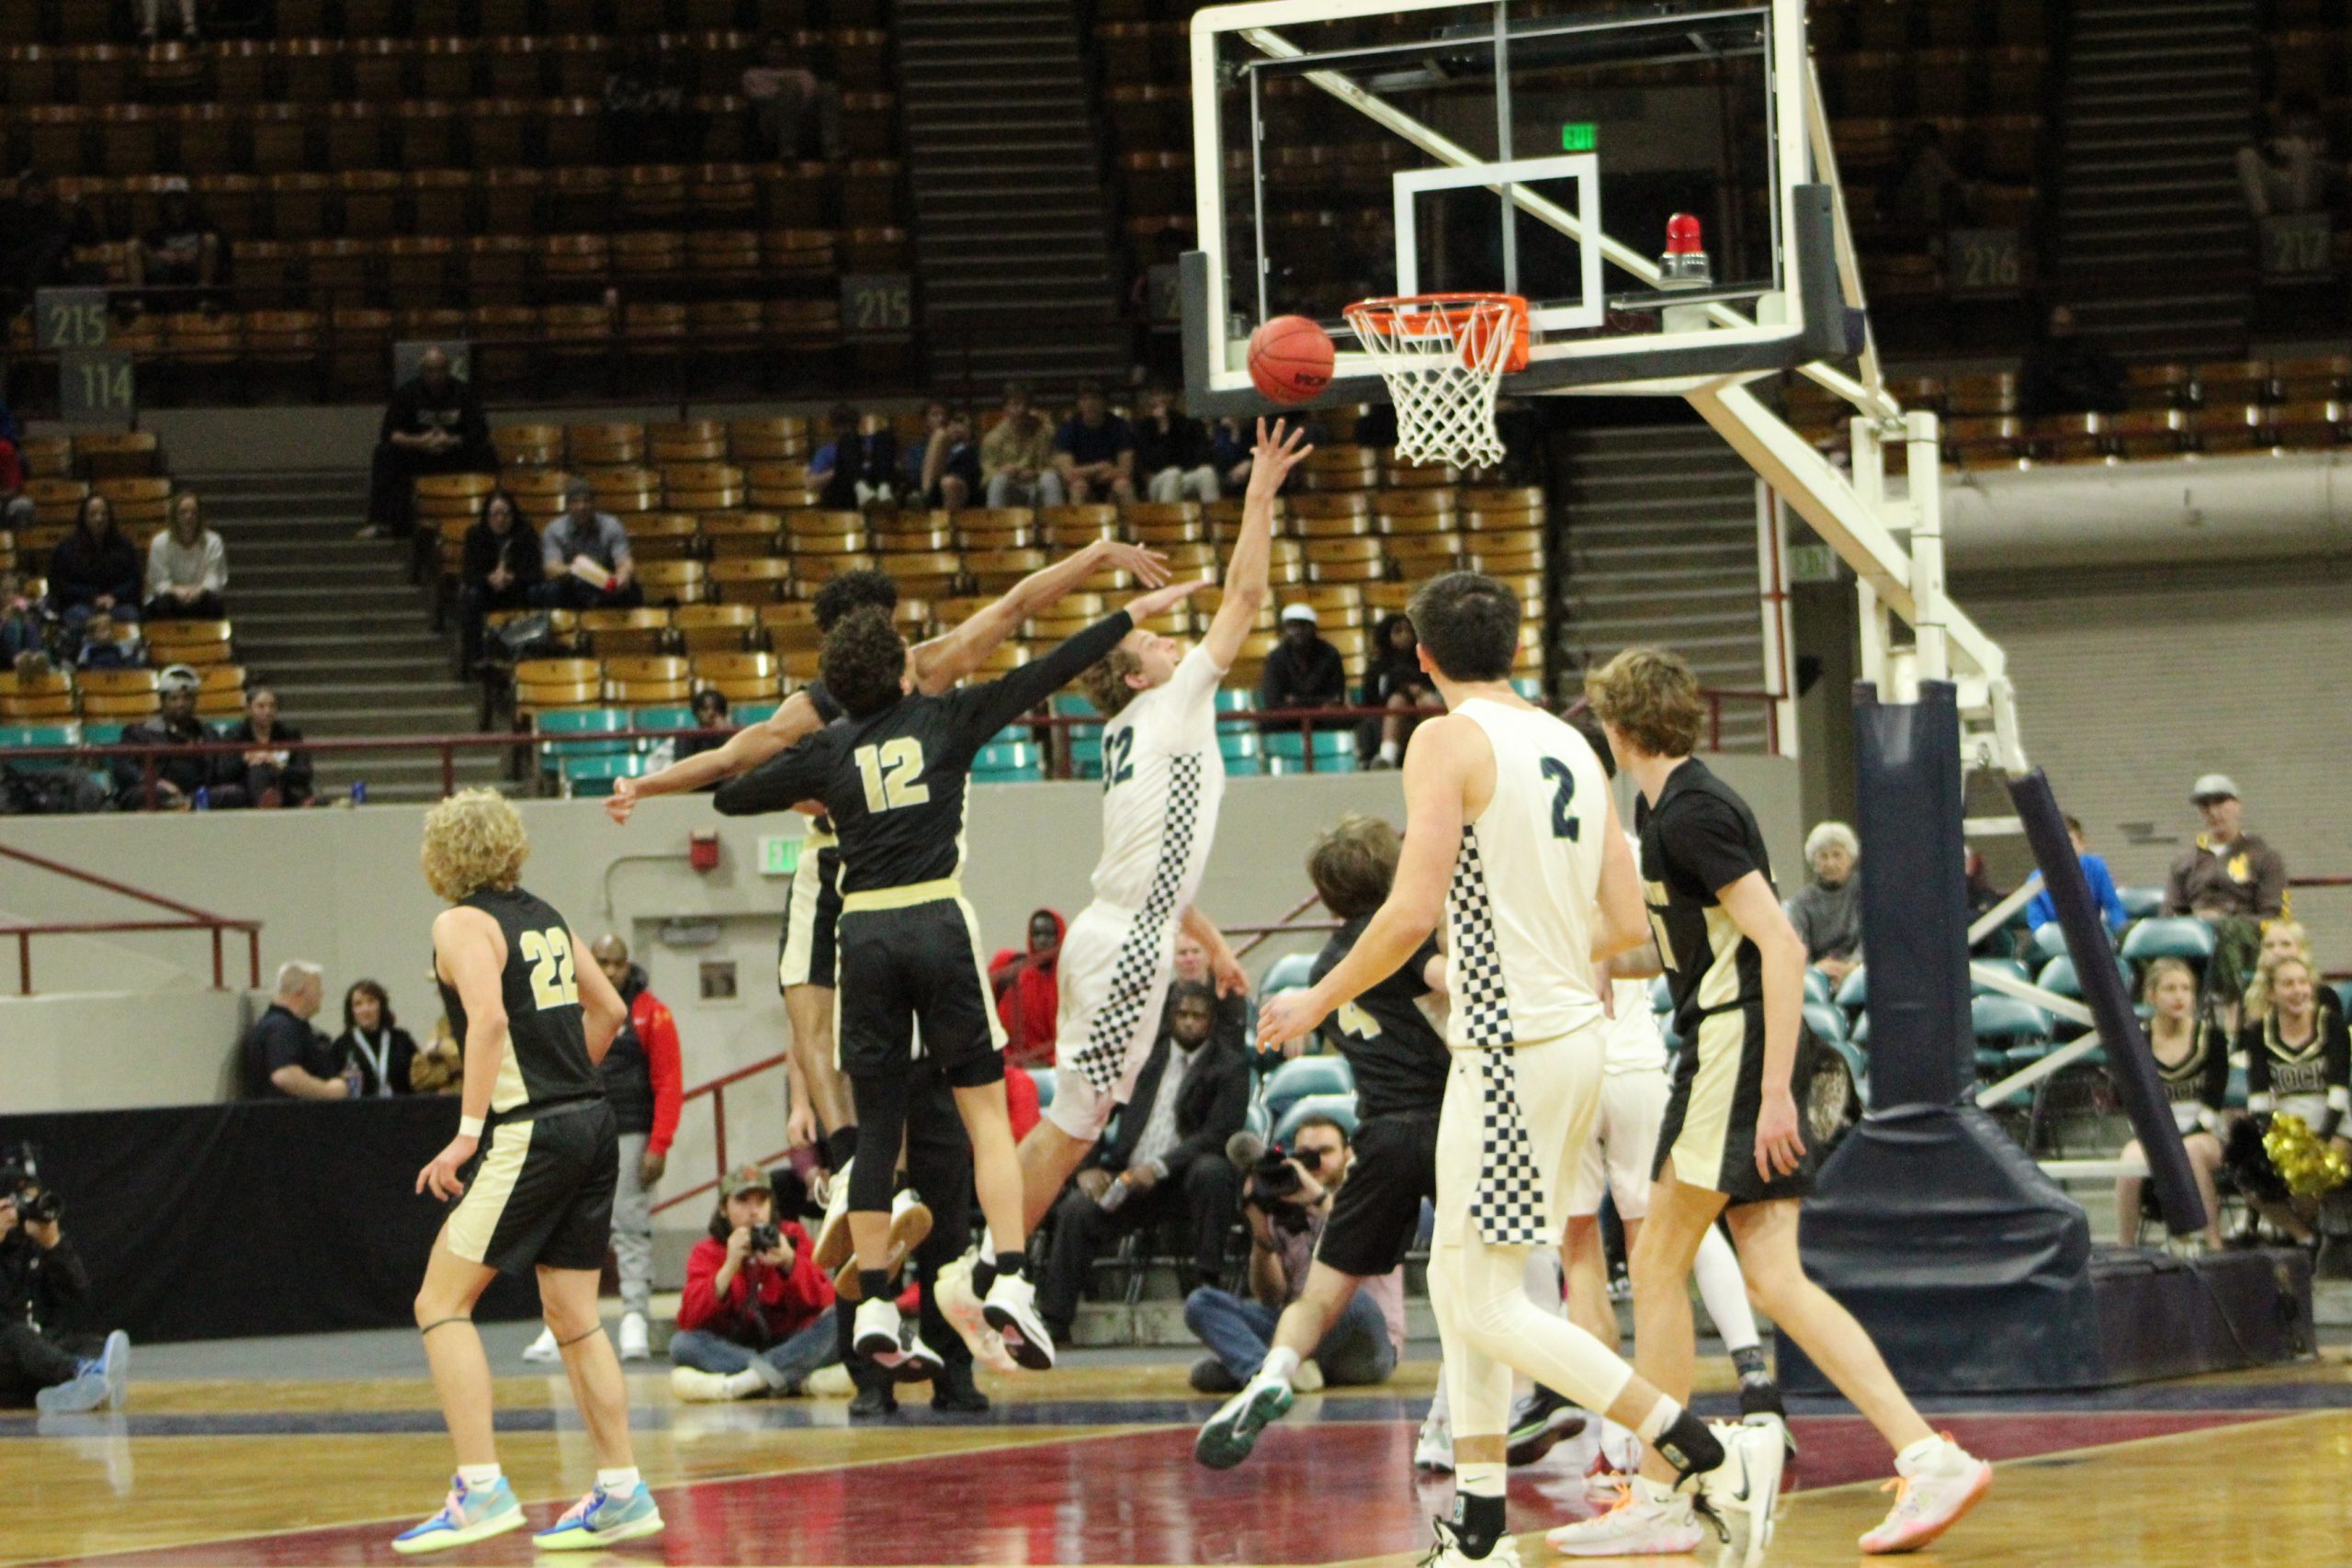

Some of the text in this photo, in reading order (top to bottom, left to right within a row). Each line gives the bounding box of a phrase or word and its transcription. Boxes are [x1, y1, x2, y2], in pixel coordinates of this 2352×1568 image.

[1962, 245, 2018, 287] 216
[50, 304, 107, 346] 215
[854, 288, 911, 329] 215
[80, 365, 131, 407] 114
[854, 736, 929, 814] 12
[1540, 755, 1580, 843] 2
[519, 926, 579, 1010] 22
